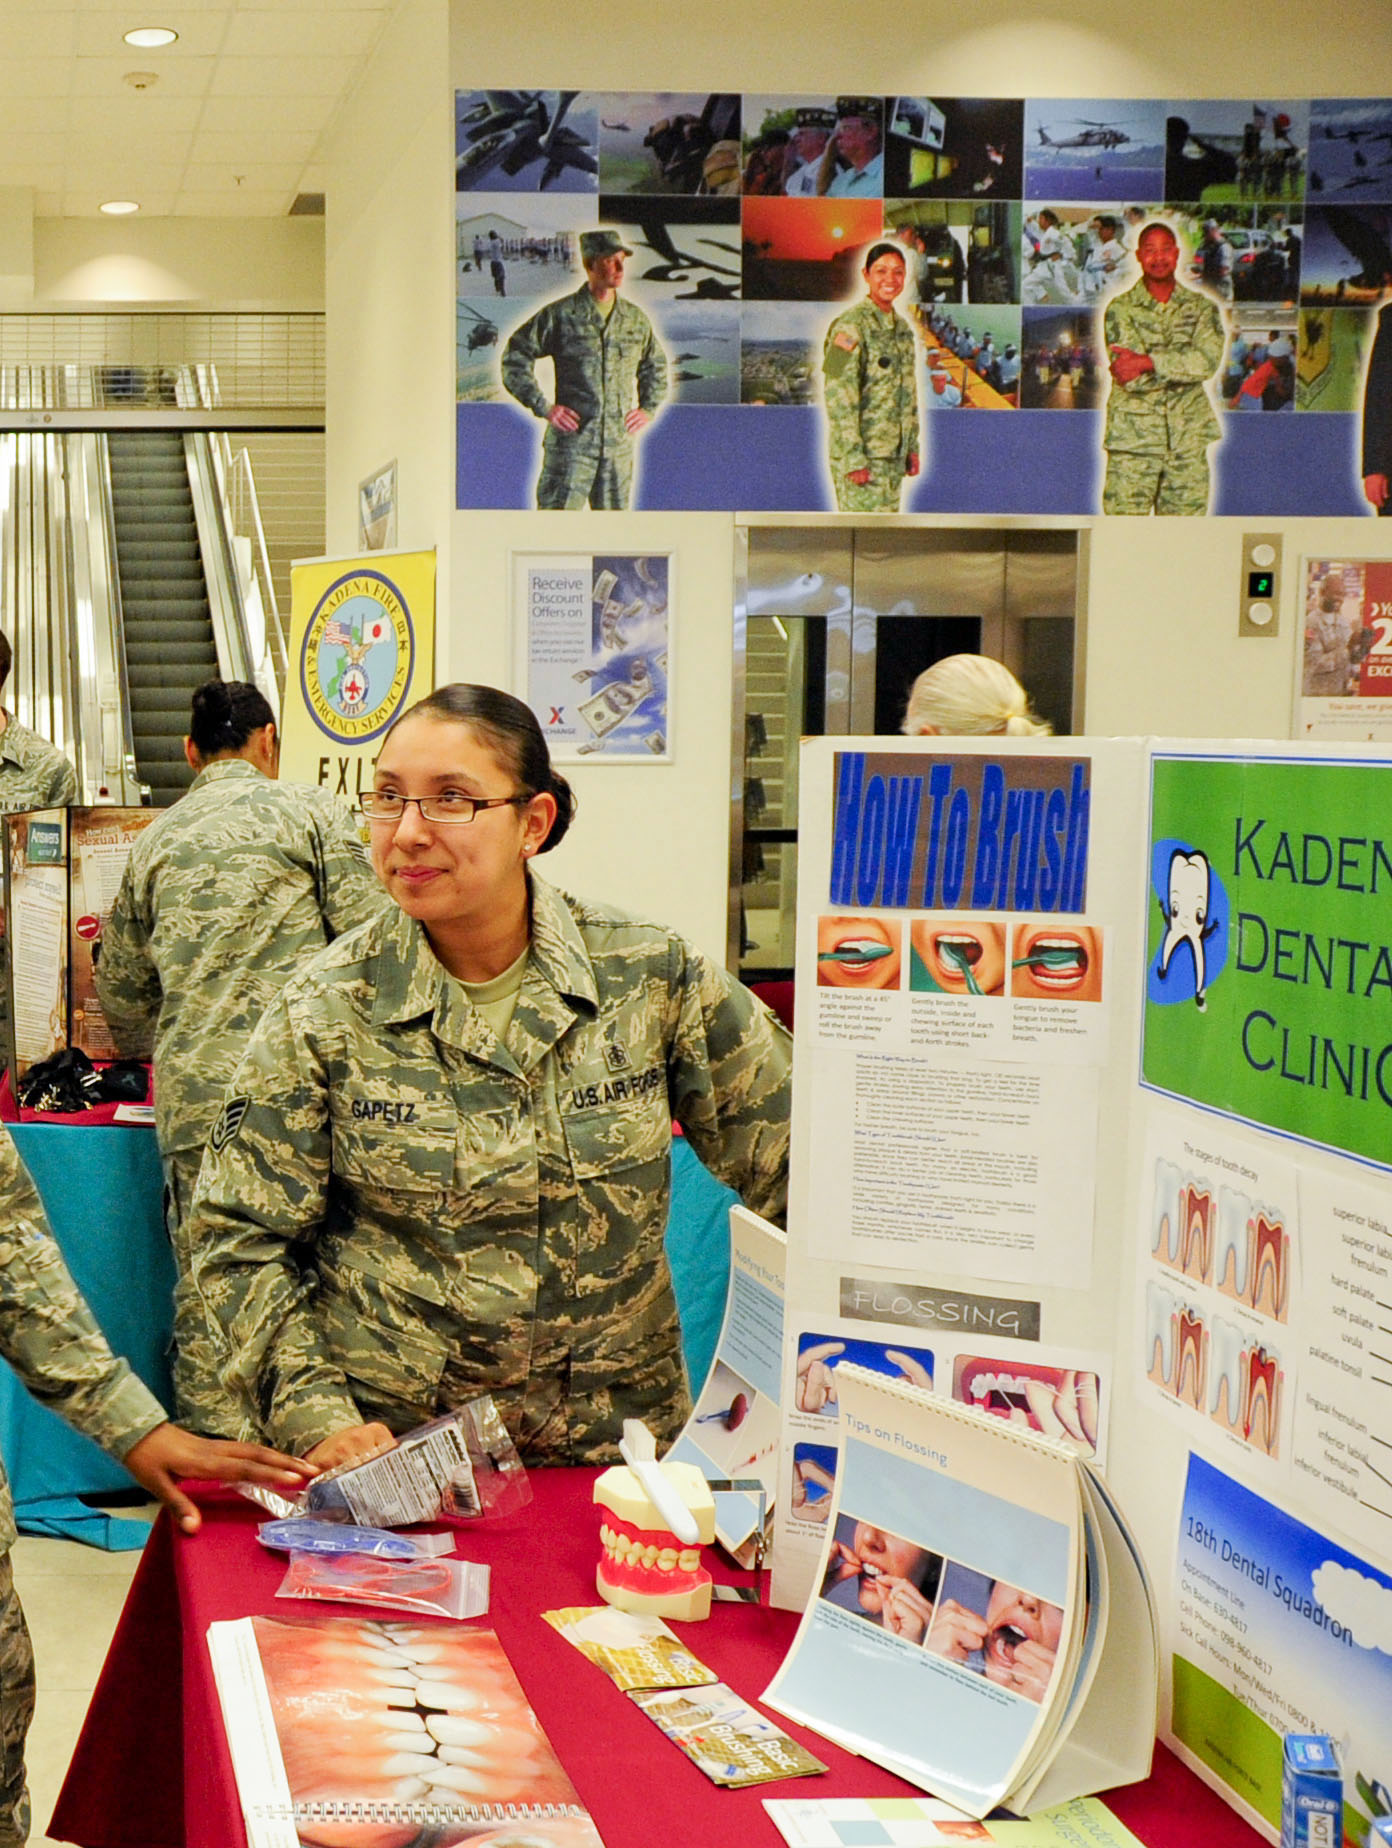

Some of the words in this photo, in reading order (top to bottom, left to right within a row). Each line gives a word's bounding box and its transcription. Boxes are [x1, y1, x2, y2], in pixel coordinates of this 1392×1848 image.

[320, 580, 369, 623] KADENA
[372, 583, 400, 615] FIRE
[532, 577, 583, 591] Receive
[532, 592, 584, 604] Discount
[532, 606, 566, 618] Offers
[567, 608, 583, 618] on
[318, 757, 377, 796] EXI
[77, 832, 119, 846] Sexual
[829, 750, 925, 908] How
[923, 763, 971, 911] To
[970, 762, 1092, 914] Brush
[1232, 816, 1392, 894] KADEN
[1235, 911, 1392, 999] DENTA
[603, 1080, 629, 1104] AIR
[351, 1100, 416, 1124] GAPETZ
[852, 1289, 1021, 1337] FLOSSING
[845, 1412, 871, 1434] Tips
[874, 1427, 891, 1442] on
[893, 1431, 949, 1468] Flossing
[1186, 1516, 1218, 1554] 18th
[1221, 1539, 1271, 1590] Dental
[1272, 1574, 1354, 1648] Squadron
[708, 1724, 772, 1776] Brushing
[757, 1739, 799, 1771] Basic
